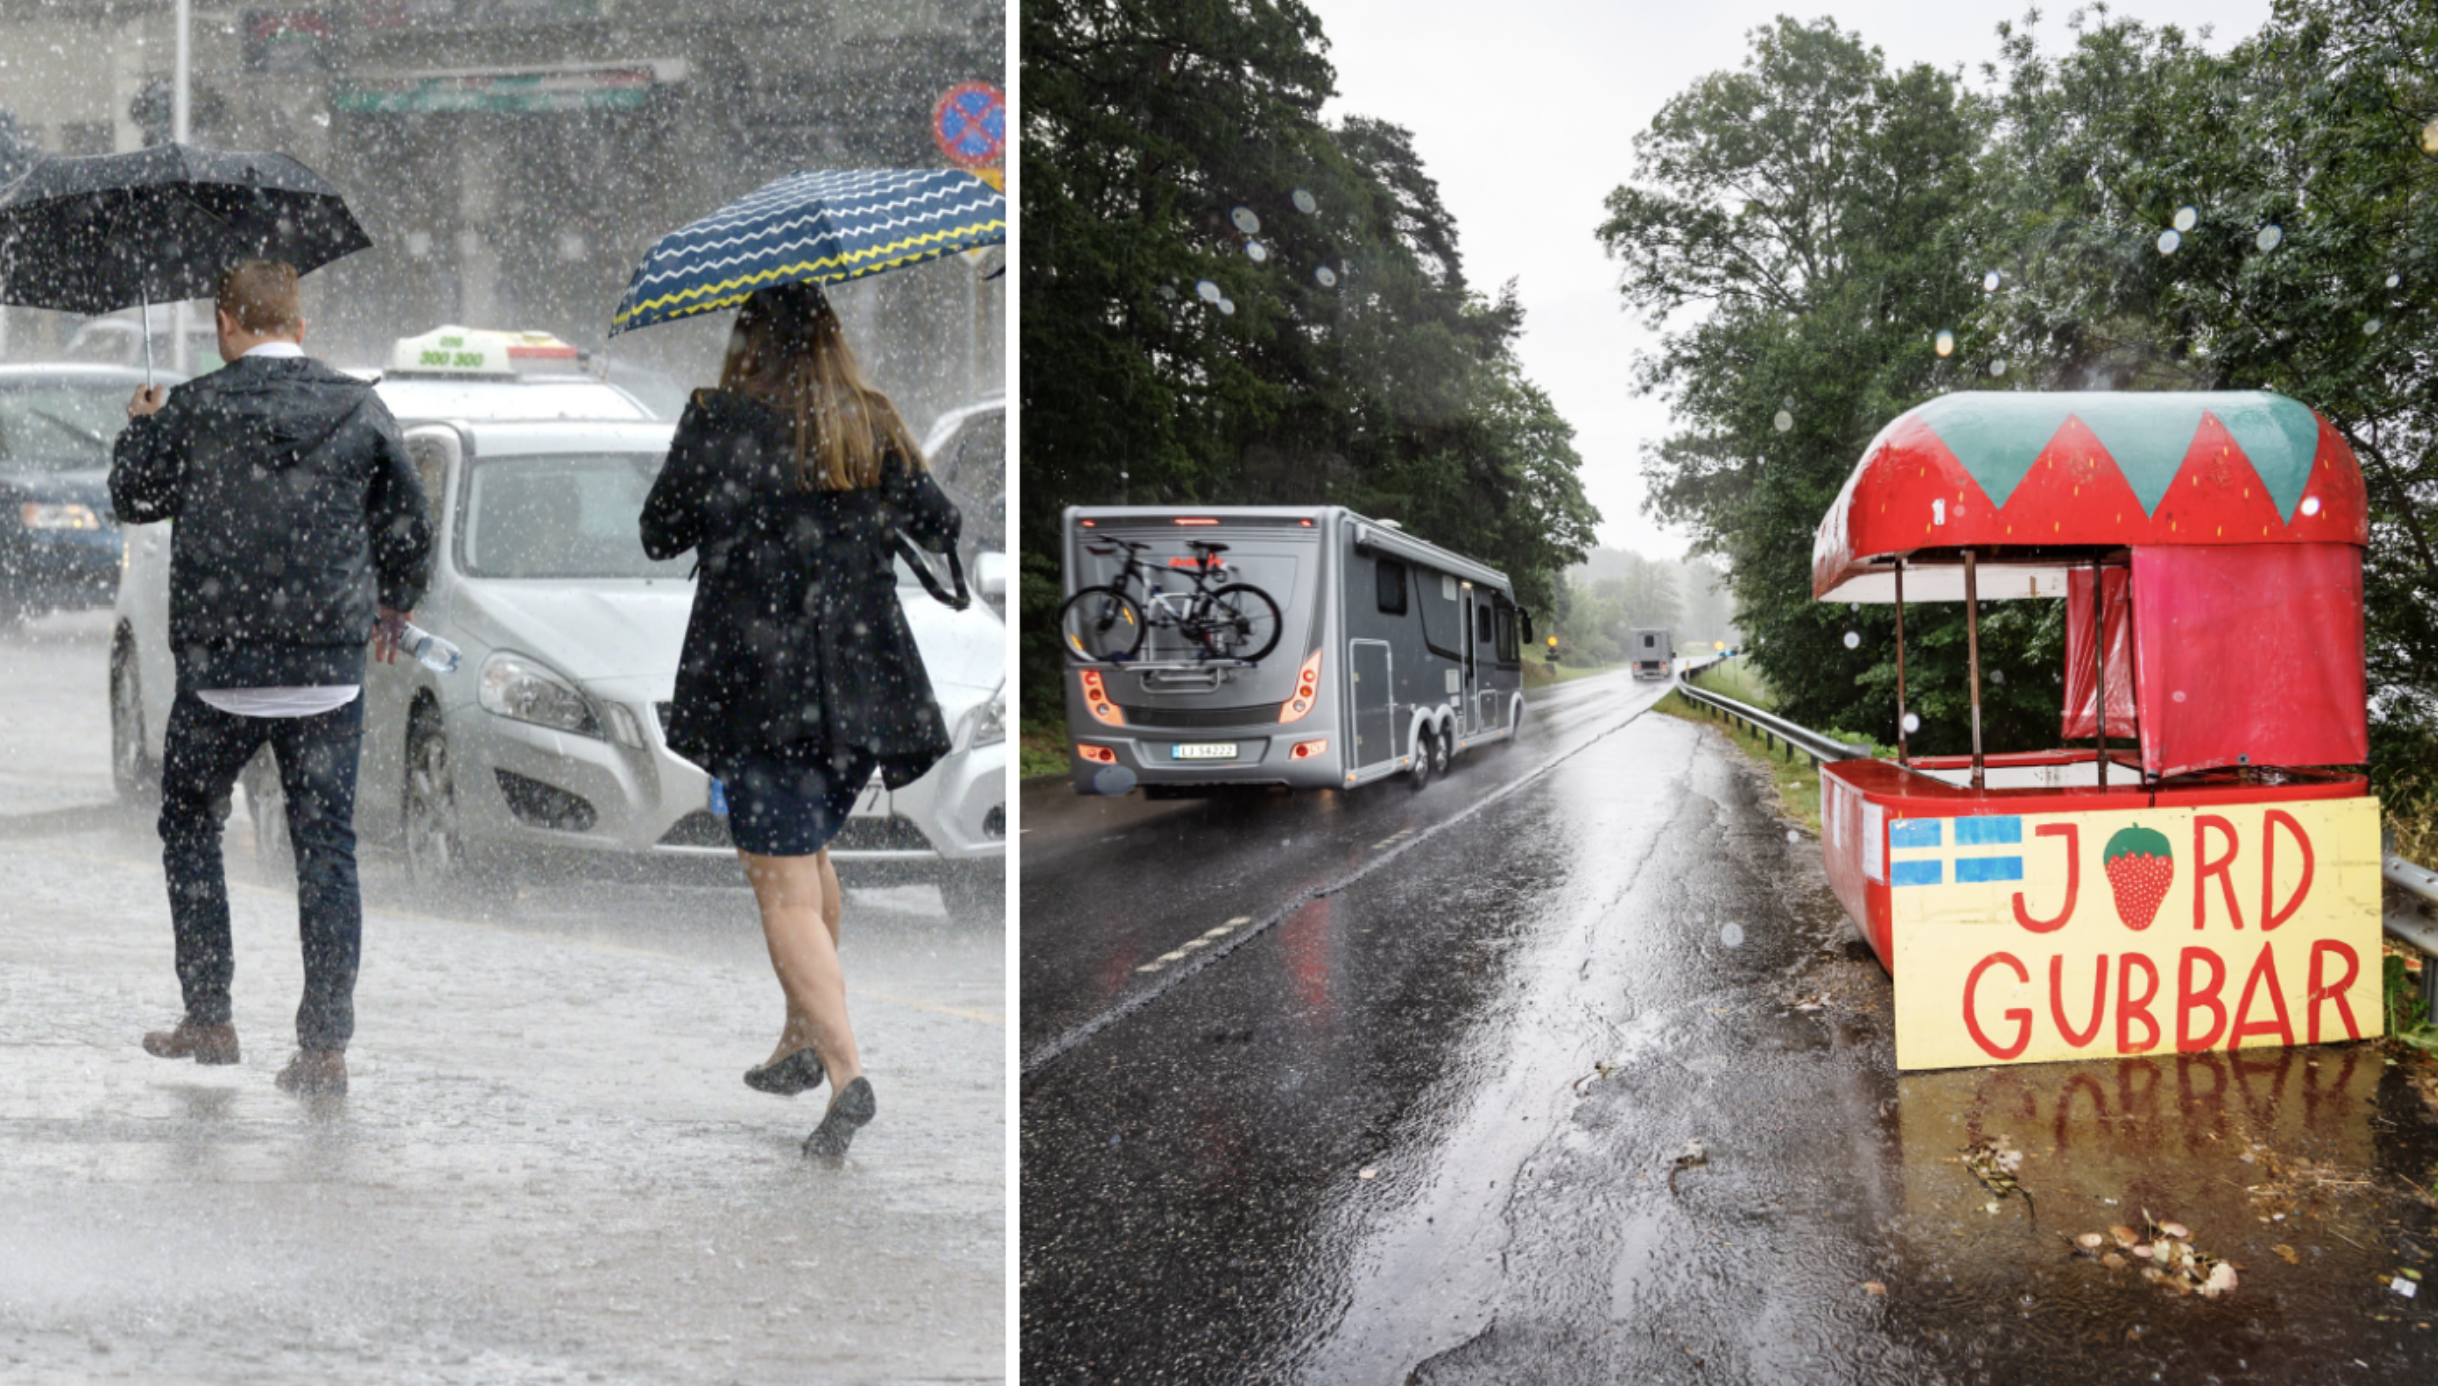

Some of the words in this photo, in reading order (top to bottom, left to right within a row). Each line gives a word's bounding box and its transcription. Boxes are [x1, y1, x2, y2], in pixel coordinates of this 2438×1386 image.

[419, 350, 451, 366] 300
[453, 351, 485, 368] 300
[1963, 939, 2362, 1060] GUBBAR
